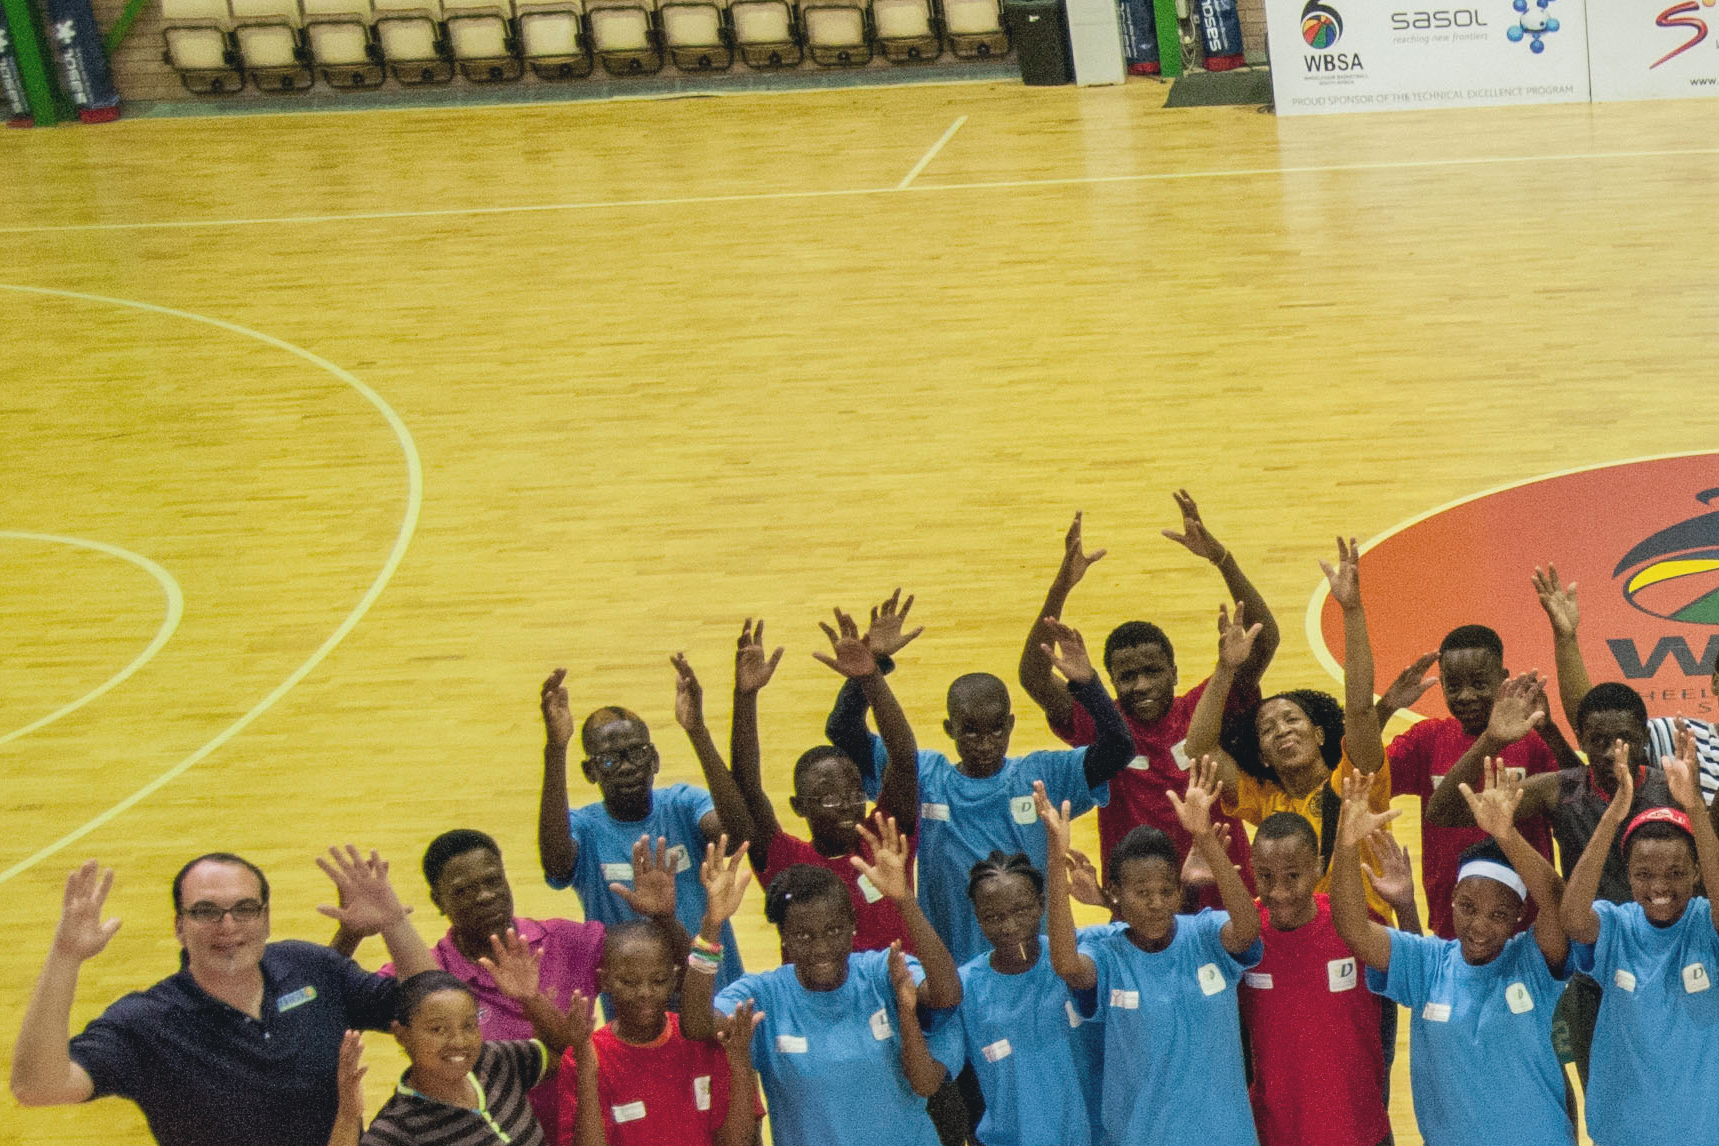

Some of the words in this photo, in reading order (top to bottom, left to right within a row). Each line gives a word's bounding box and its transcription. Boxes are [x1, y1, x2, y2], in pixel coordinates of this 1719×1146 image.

[1304, 53, 1364, 72] WBSA
[1292, 96, 1326, 106] PROUD
[1328, 94, 1374, 105] SPONSOR
[1376, 93, 1388, 104] OF
[1393, 92, 1410, 102] THE
[1413, 89, 1463, 101] TECHNICAL
[1467, 86, 1522, 98] EXCELLENCE
[1526, 85, 1574, 96] PROGRAM
[1340, 963, 1353, 977] D
[1693, 967, 1704, 980] D
